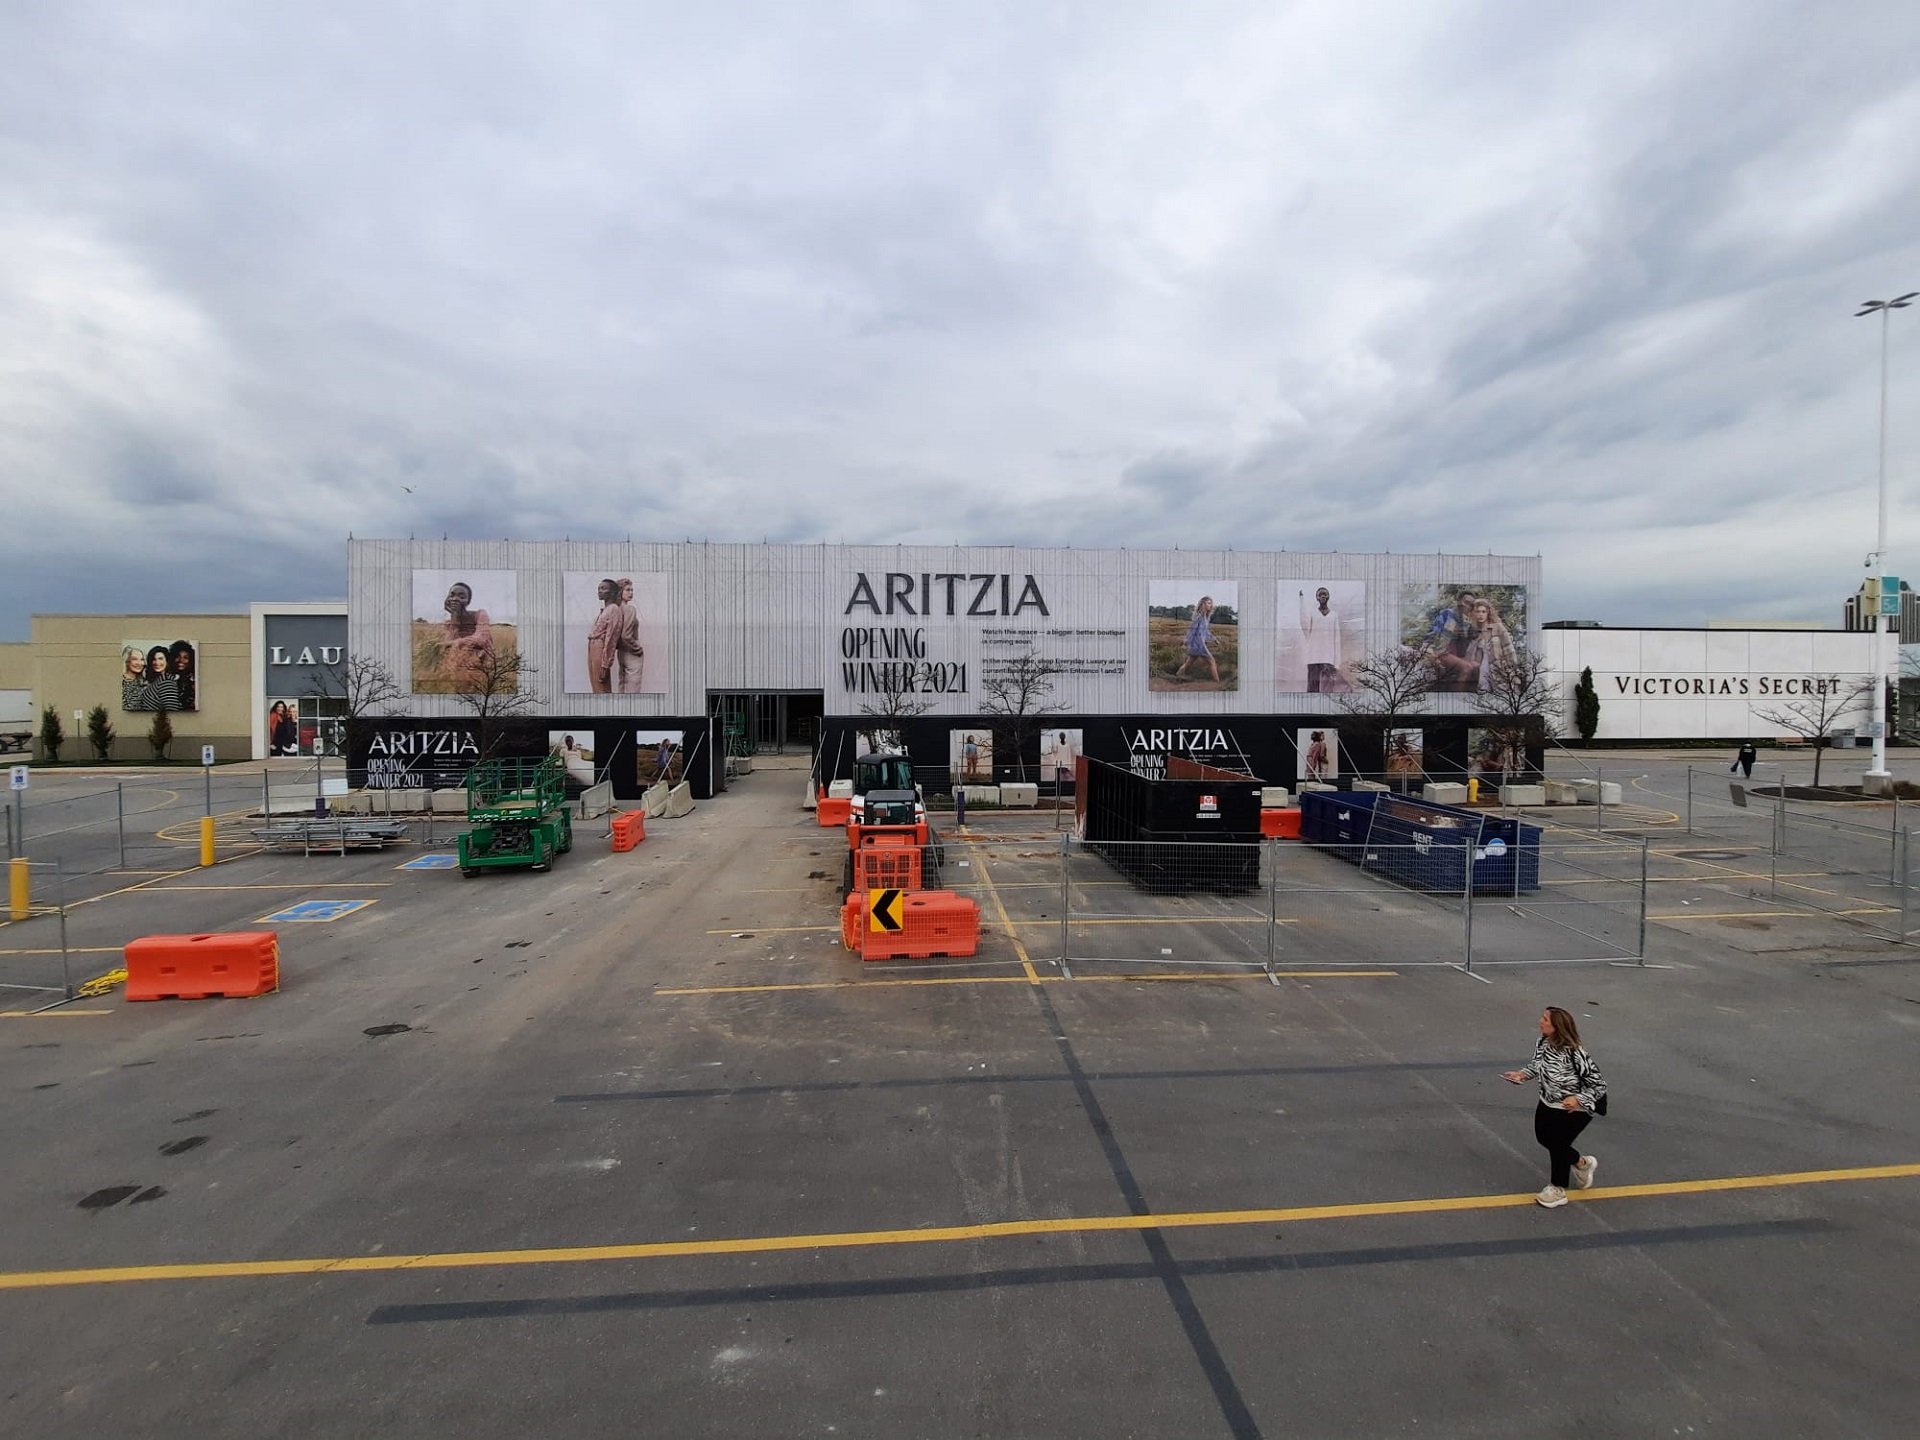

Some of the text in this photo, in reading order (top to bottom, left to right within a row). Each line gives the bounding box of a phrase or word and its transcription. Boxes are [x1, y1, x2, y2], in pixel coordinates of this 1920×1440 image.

[844, 572, 1050, 616] ARITZIA
[1097, 629, 1126, 637] boutique
[841, 627, 926, 659] OPENING
[269, 646, 344, 665] LAU
[1001, 657, 1035, 665] meante,
[1086, 657, 1107, 665] Luxury
[842, 661, 969, 693] WINTER 2021
[1614, 676, 1841, 695] VICTORIA'S SECRET
[368, 731, 480, 754] ARITZIA
[1131, 729, 1229, 750] ARITZIA
[367, 758, 406, 773] OPENING
[1130, 754, 1164, 768] OPENING
[367, 773, 424, 788] WINTER 2021
[1412, 831, 1433, 845] RENT
